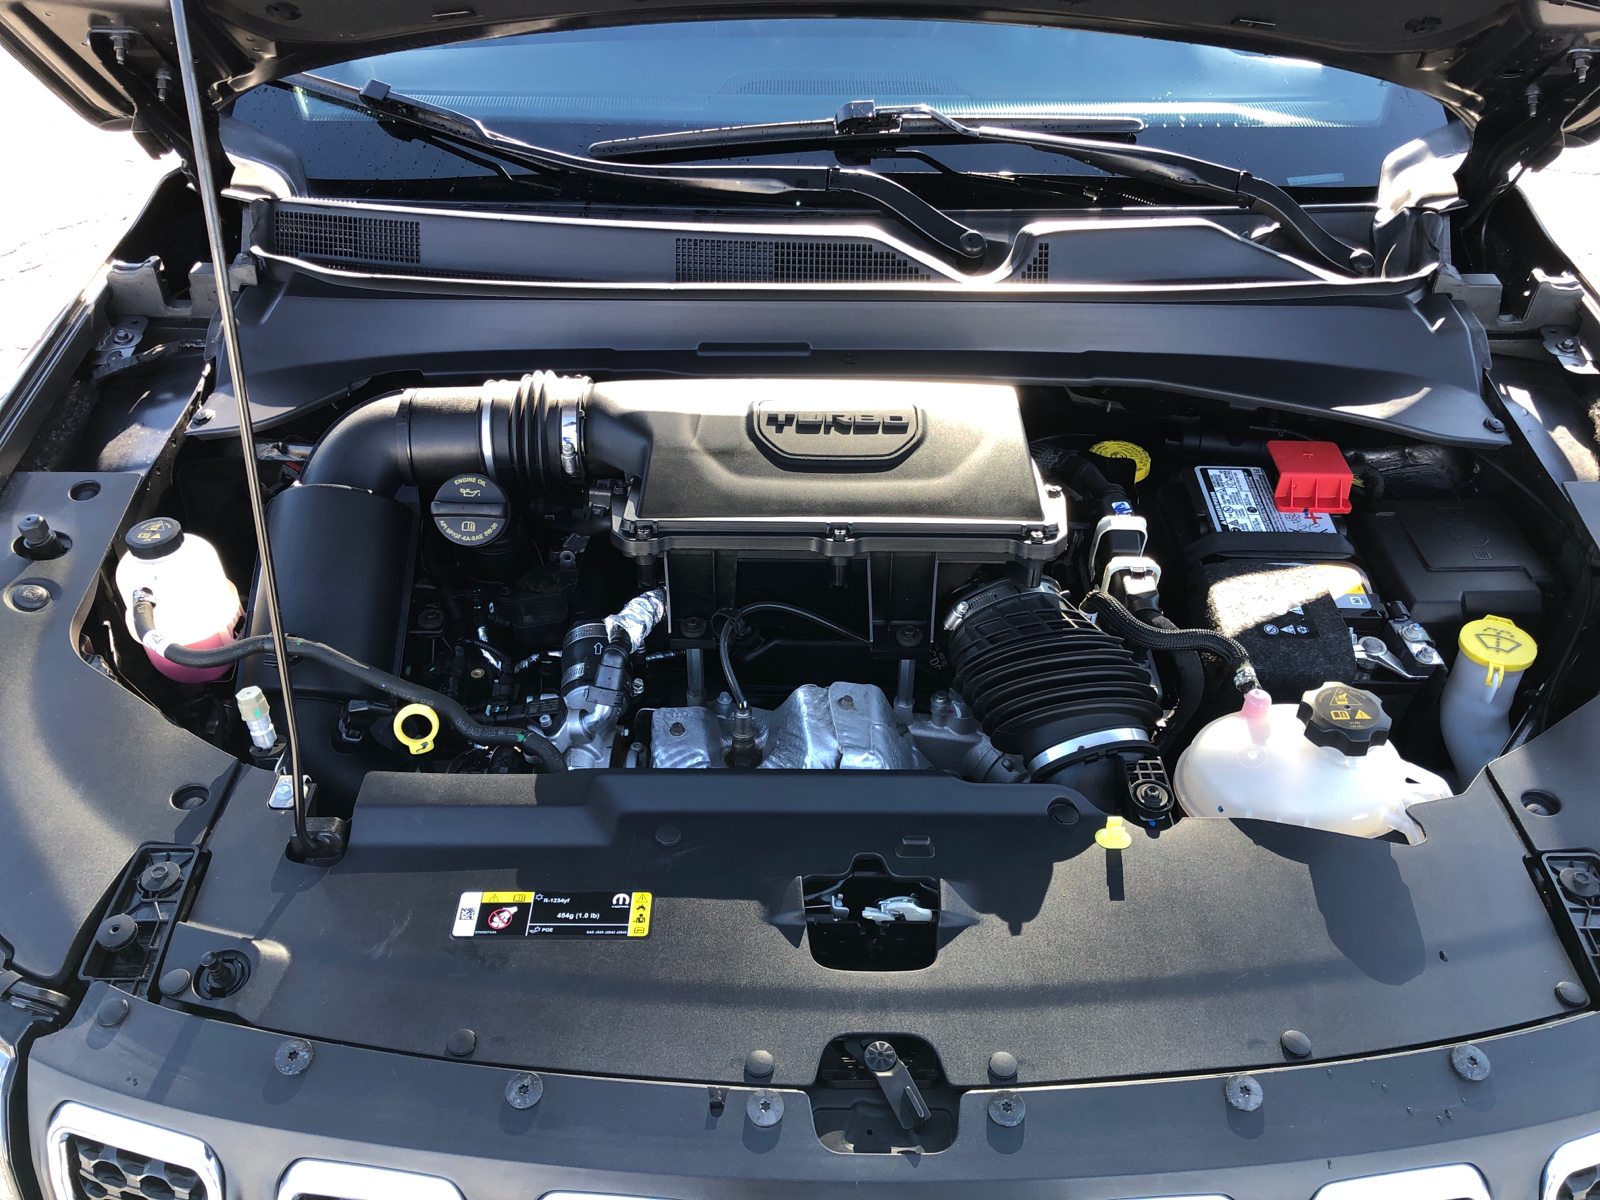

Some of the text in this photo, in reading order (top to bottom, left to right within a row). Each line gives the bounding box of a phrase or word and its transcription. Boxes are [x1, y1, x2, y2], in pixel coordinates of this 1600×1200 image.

[766, 412, 910, 435] TURBO
[454, 477, 487, 487] ENGINE OIL
[439, 520, 448, 530] API
[575, 912, 589, 920] (1.0
[590, 912, 600, 920] lb)
